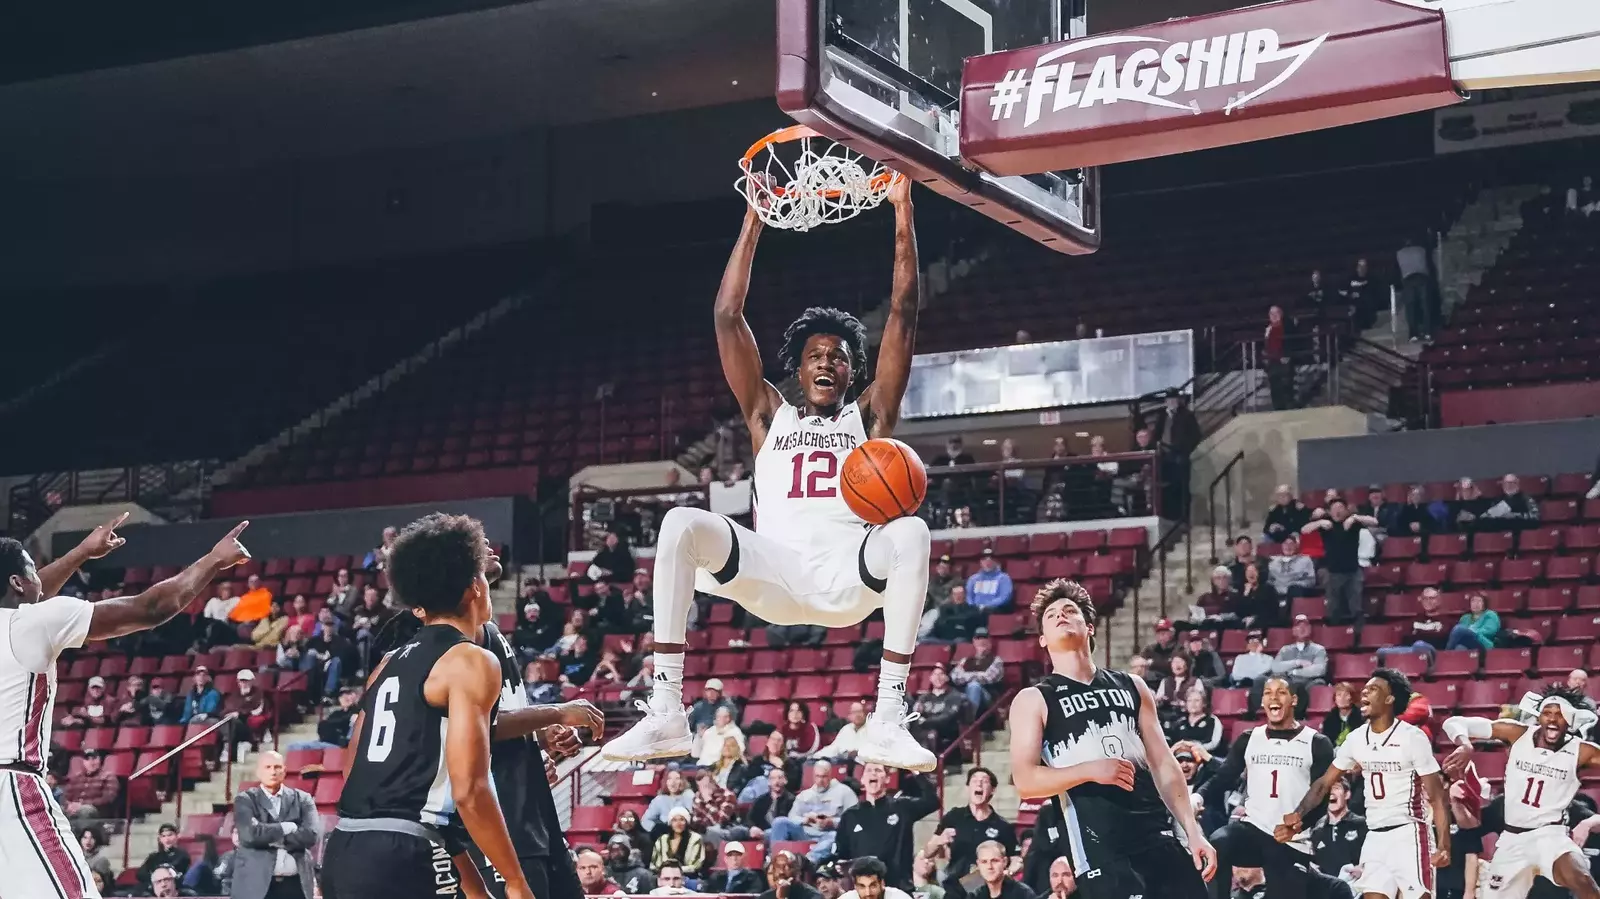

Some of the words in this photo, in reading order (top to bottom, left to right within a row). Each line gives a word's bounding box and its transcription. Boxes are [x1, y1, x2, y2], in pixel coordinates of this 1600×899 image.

[989, 28, 1329, 128] #FLAGSHIP
[773, 431, 857, 450] MASSACHUSETTS
[787, 451, 838, 498] 12
[1059, 689, 1135, 718] BOSTON
[367, 676, 400, 762] 6
[1269, 769, 1279, 798] 1
[1370, 772, 1386, 800] 0
[1521, 777, 1544, 808] 11
